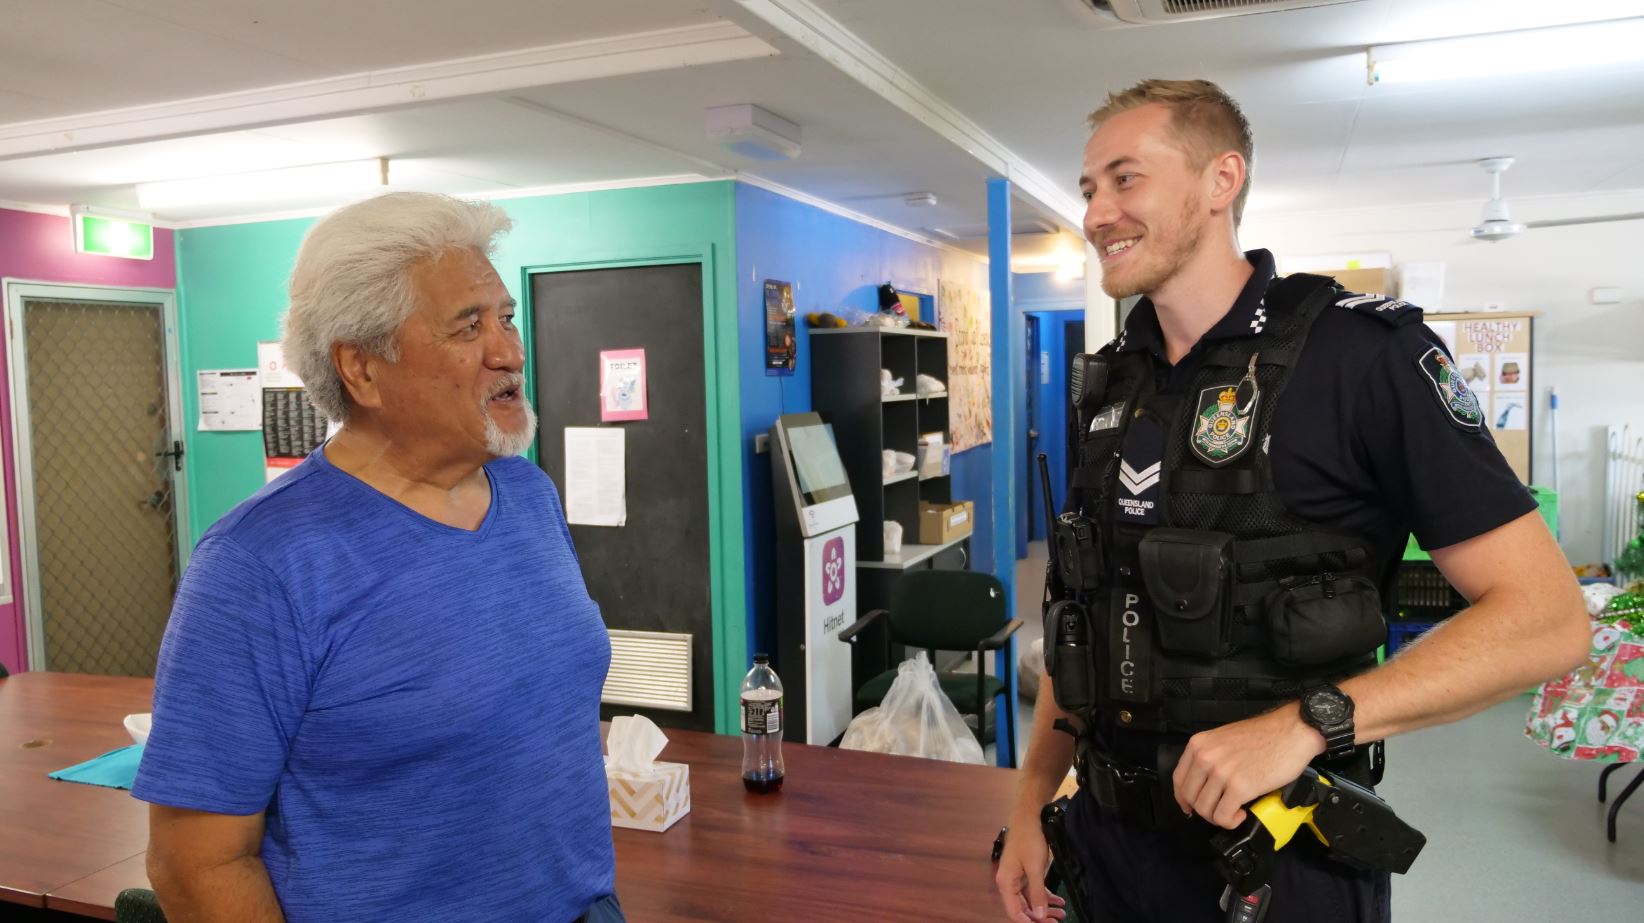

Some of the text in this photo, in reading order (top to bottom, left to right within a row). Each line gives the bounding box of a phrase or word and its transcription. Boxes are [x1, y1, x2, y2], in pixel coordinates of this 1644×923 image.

[1464, 321, 1518, 333] HEALTHY
[1469, 333, 1510, 343] LUNCH
[1476, 343, 1502, 353] BOX
[1118, 498, 1154, 509] QUEENSLAND
[1124, 506, 1145, 515] POLICE
[823, 607, 844, 635] Hitnet
[1120, 593, 1140, 694] POLICE
